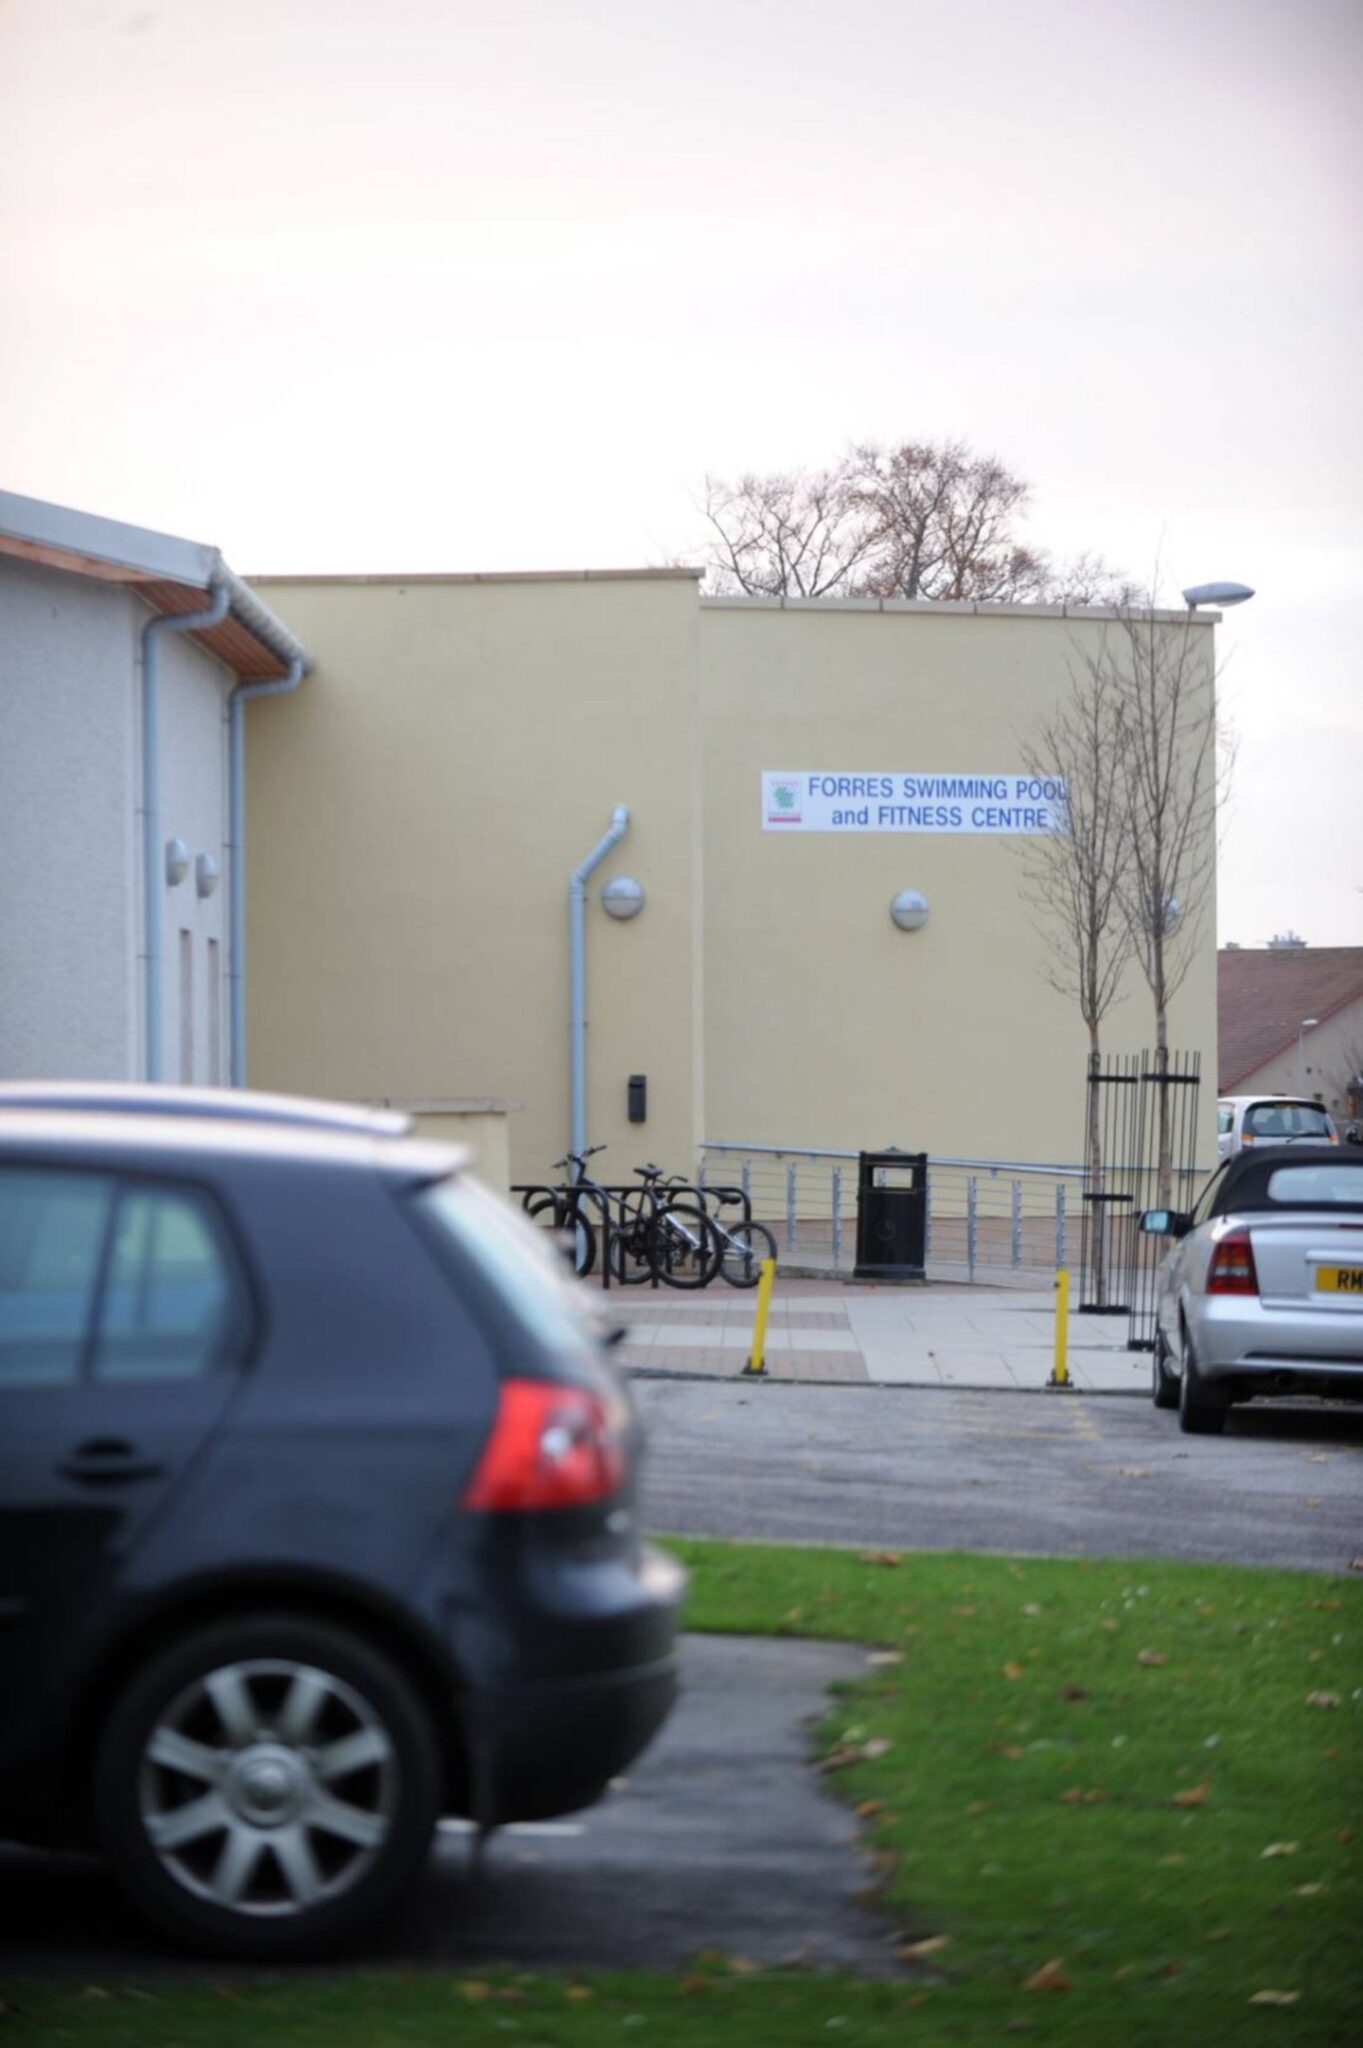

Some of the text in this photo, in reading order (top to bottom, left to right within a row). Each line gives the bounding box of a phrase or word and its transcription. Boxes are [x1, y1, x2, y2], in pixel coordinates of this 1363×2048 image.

[808, 777, 1070, 801] FORRES SWIMMING POOL
[831, 806, 1049, 828] and FITNESS CENTRE
